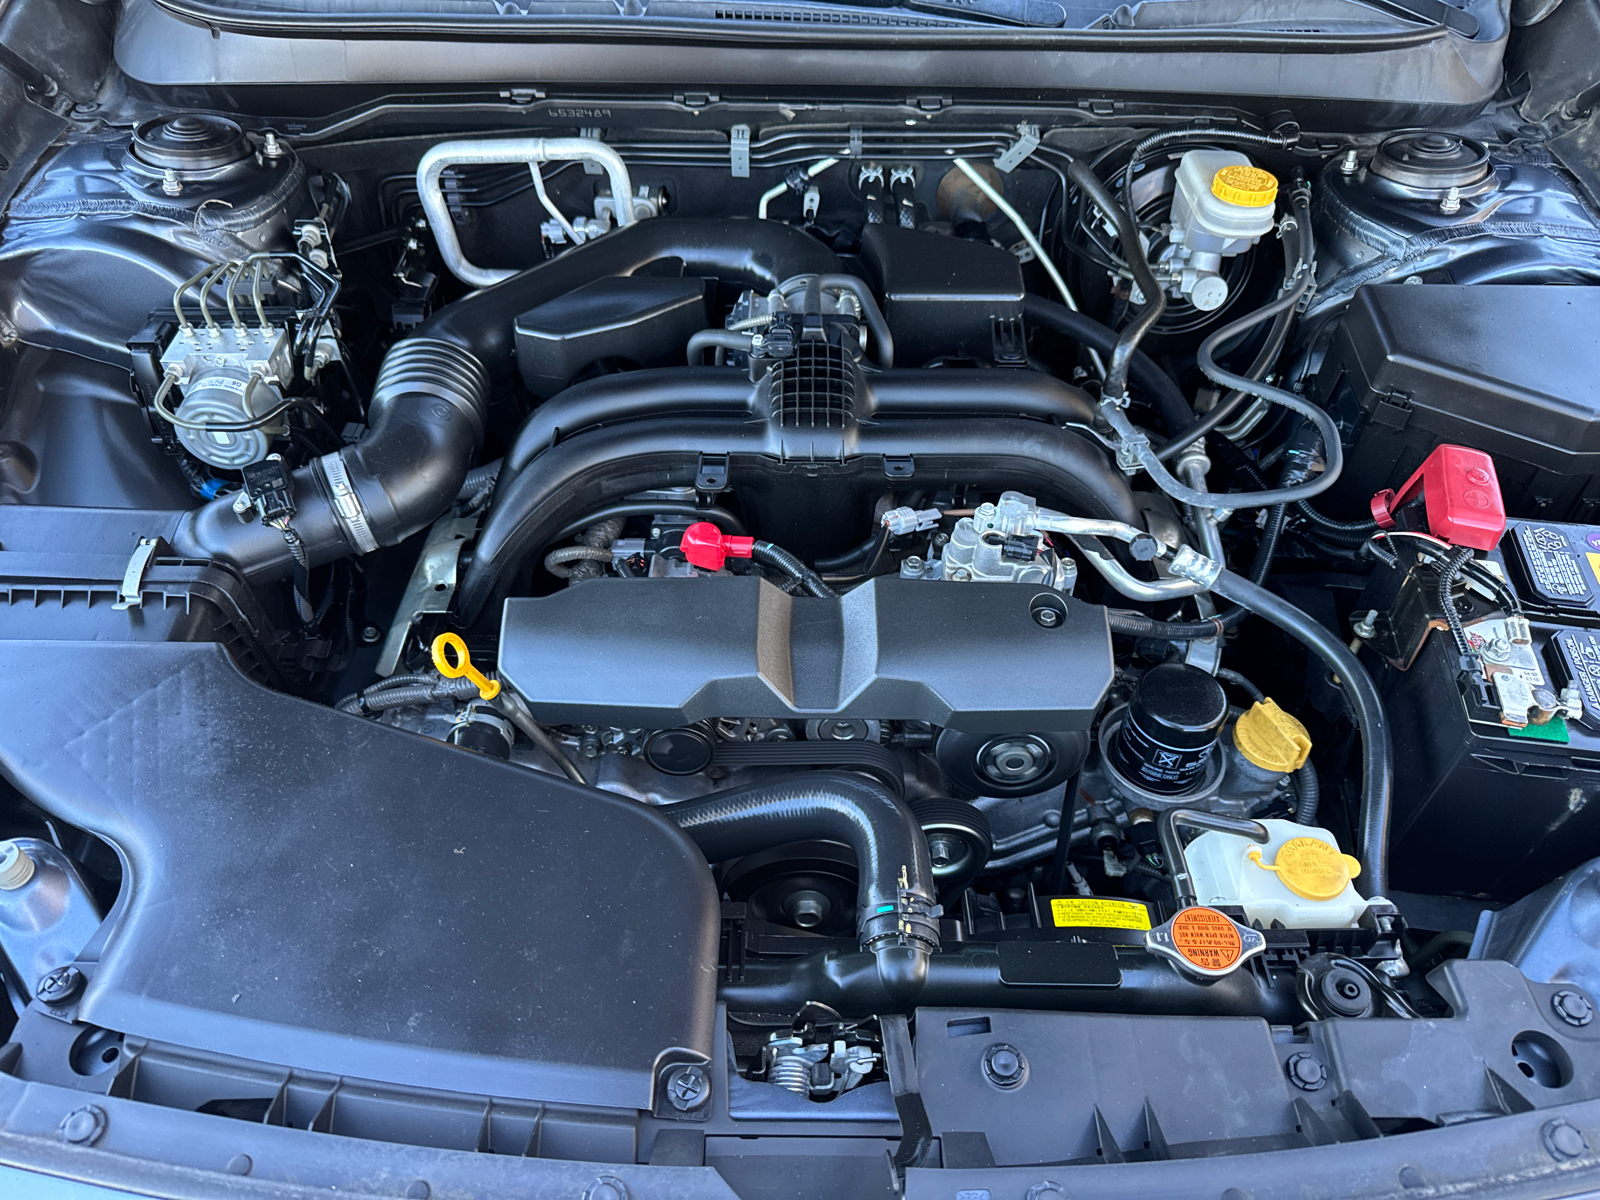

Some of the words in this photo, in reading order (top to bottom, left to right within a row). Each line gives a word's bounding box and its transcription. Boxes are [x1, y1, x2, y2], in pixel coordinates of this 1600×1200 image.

[548, 108, 612, 118] 6532489
[1281, 839, 1337, 858] COOLANT
[1188, 949, 1220, 957] WARNING
